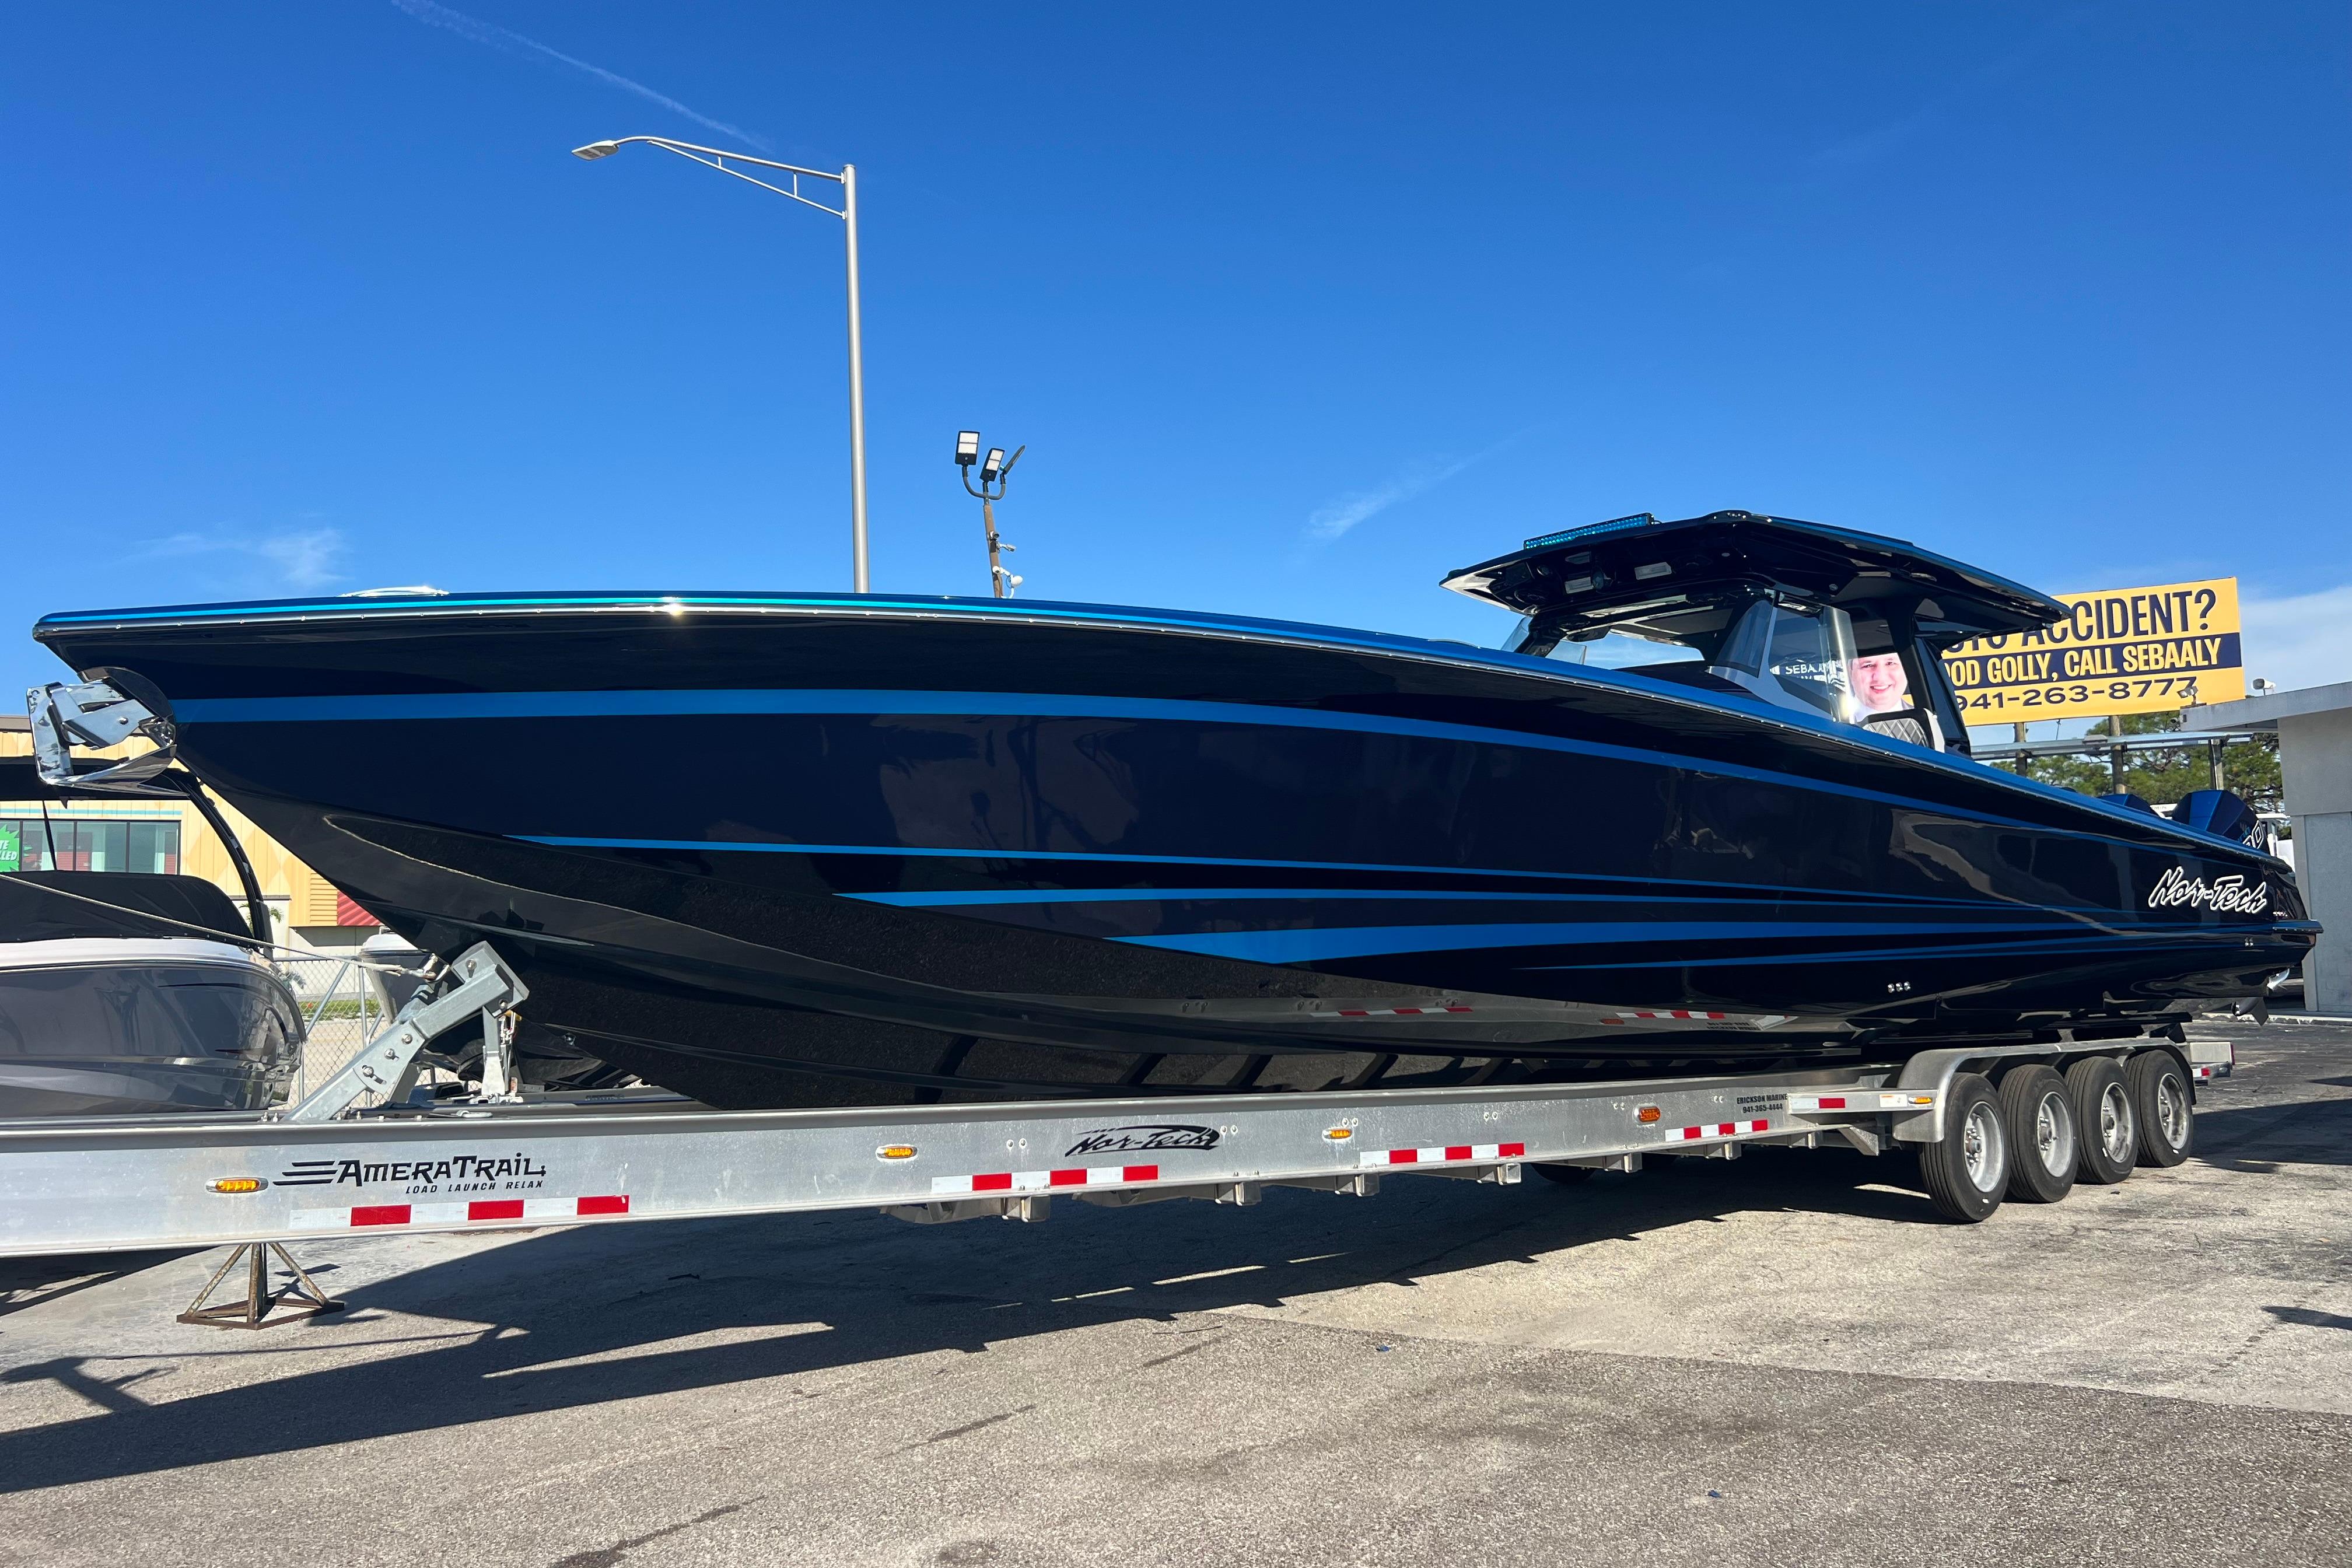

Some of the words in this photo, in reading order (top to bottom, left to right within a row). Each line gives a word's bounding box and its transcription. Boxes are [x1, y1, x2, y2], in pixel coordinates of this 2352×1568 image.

[1945, 660, 1980, 687] OD
[1987, 653, 2058, 684] GOLLY,
[2064, 647, 2118, 677] CALL
[2122, 638, 2221, 672] SEBAALY
[2148, 866, 2267, 914] Nor-Tech
[1737, 1095, 1765, 1104] ERICKSON
[1766, 1093, 1788, 1101] MARINE
[1742, 1102, 1783, 1114] 941-365-4444
[1065, 1126, 1217, 1157] Nor-Tech
[405, 1185, 438, 1194] LOAD
[448, 1182, 496, 1192] LAUNCH
[506, 1180, 543, 1189] RELAX
